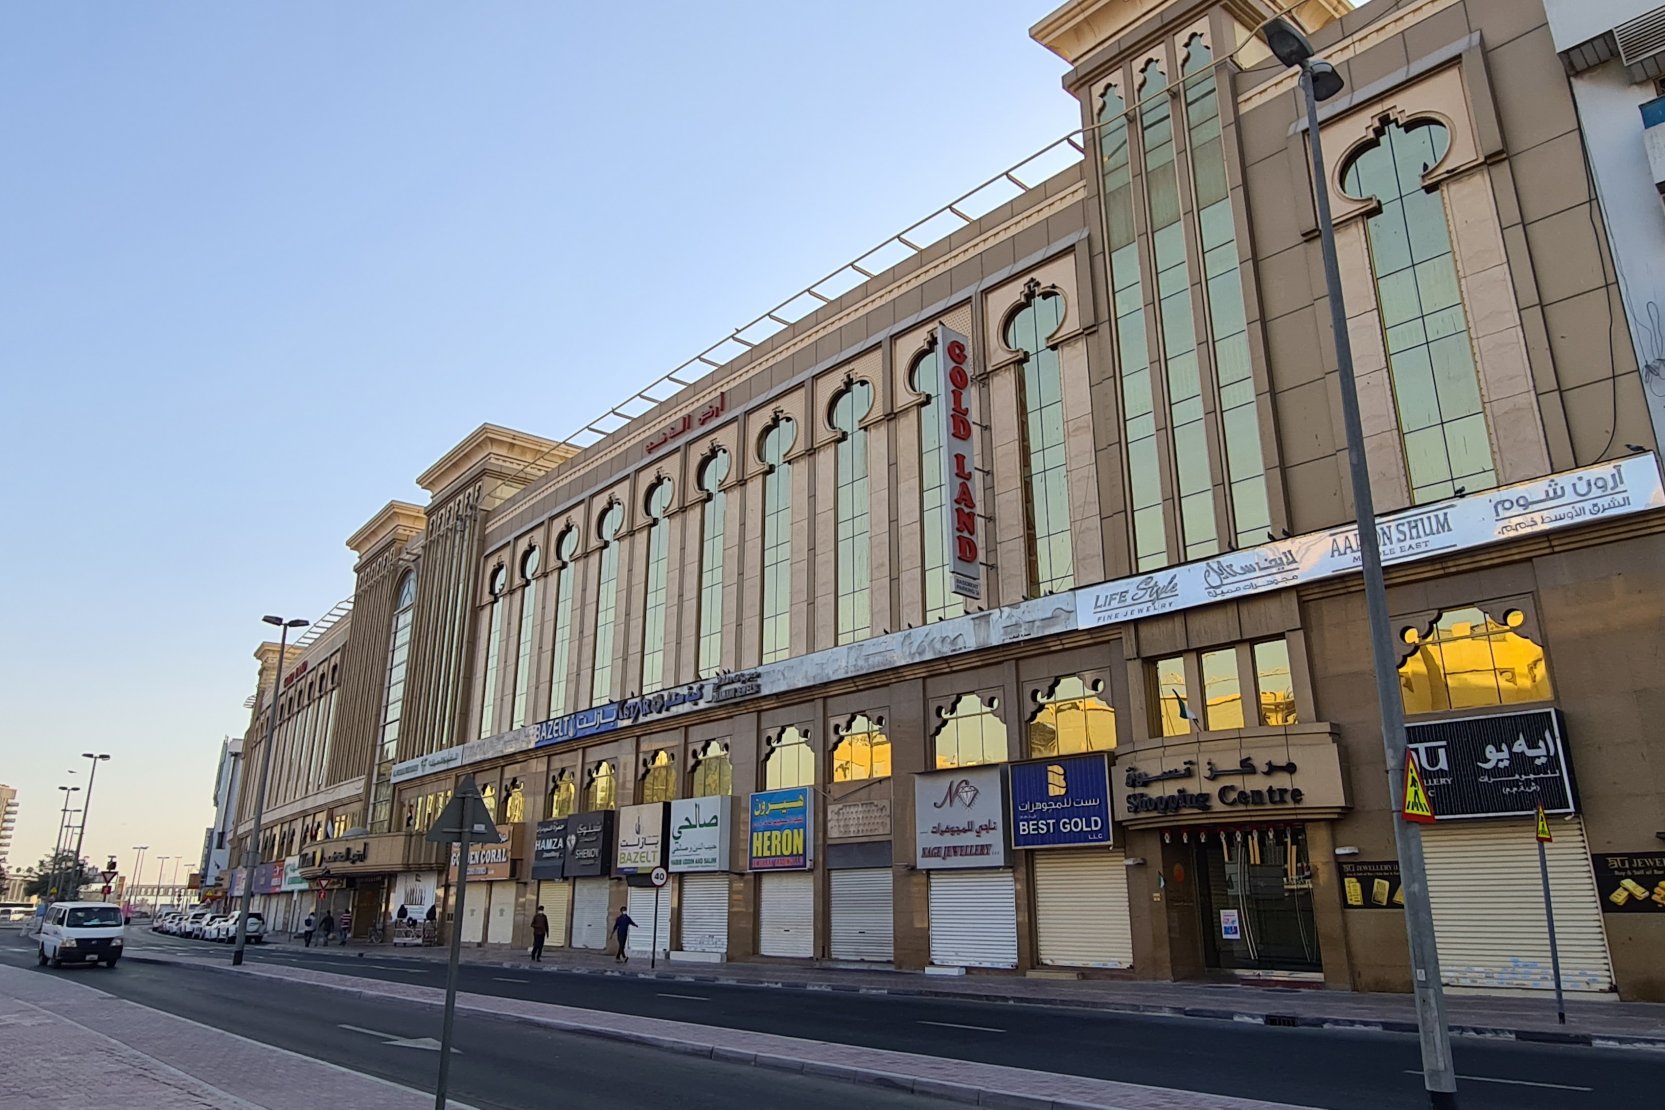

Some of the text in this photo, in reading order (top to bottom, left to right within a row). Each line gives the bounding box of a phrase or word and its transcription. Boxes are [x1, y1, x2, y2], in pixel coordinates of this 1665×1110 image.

[947, 339, 978, 564] GOLD LAND
[1330, 511, 1453, 558] AAN SHUM
[1399, 540, 1431, 554] EAST
[1093, 573, 1178, 610] LIFE Style
[1096, 600, 1174, 624] FINE JEWELRY
[534, 716, 570, 742] BAZELT
[1126, 784, 1305, 815] Shopping Centre
[1019, 816, 1102, 835] BEST GOLD
[535, 838, 564, 851] HAMZA
[752, 829, 805, 858] HERON
[451, 848, 507, 866] GOEN CORAL
[619, 850, 659, 864] BAZELT
[654, 872, 665, 881] 40
